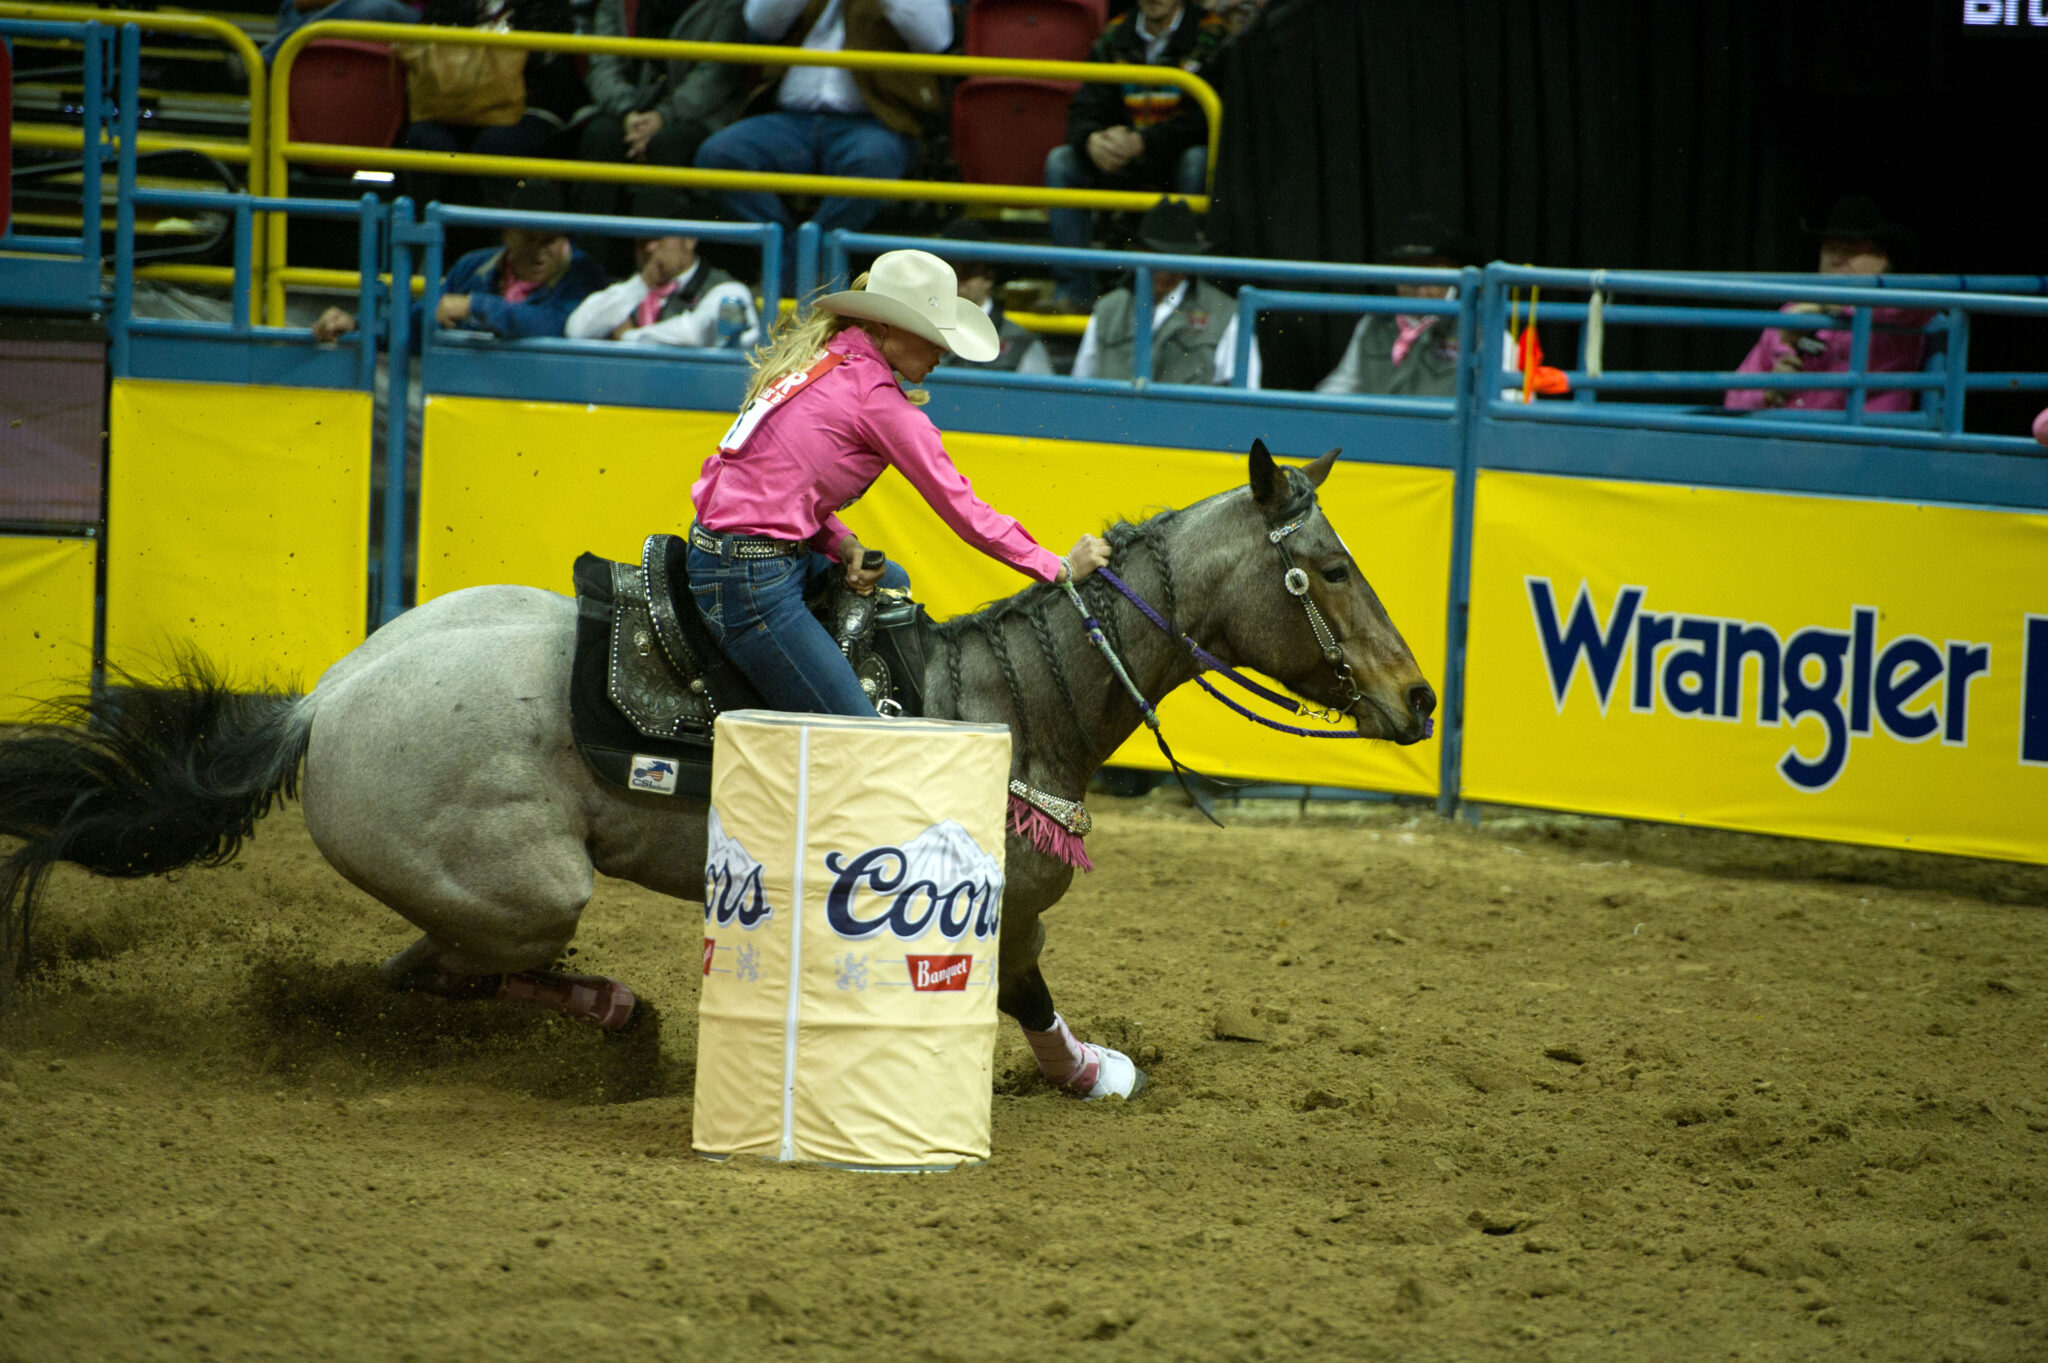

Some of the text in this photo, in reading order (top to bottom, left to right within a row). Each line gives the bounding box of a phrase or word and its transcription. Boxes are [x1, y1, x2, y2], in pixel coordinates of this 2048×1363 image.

[1524, 575, 1991, 793] Wrangler
[631, 778, 653, 788] CSI
[825, 846, 1004, 940] Coors
[917, 959, 968, 987] Banquet
